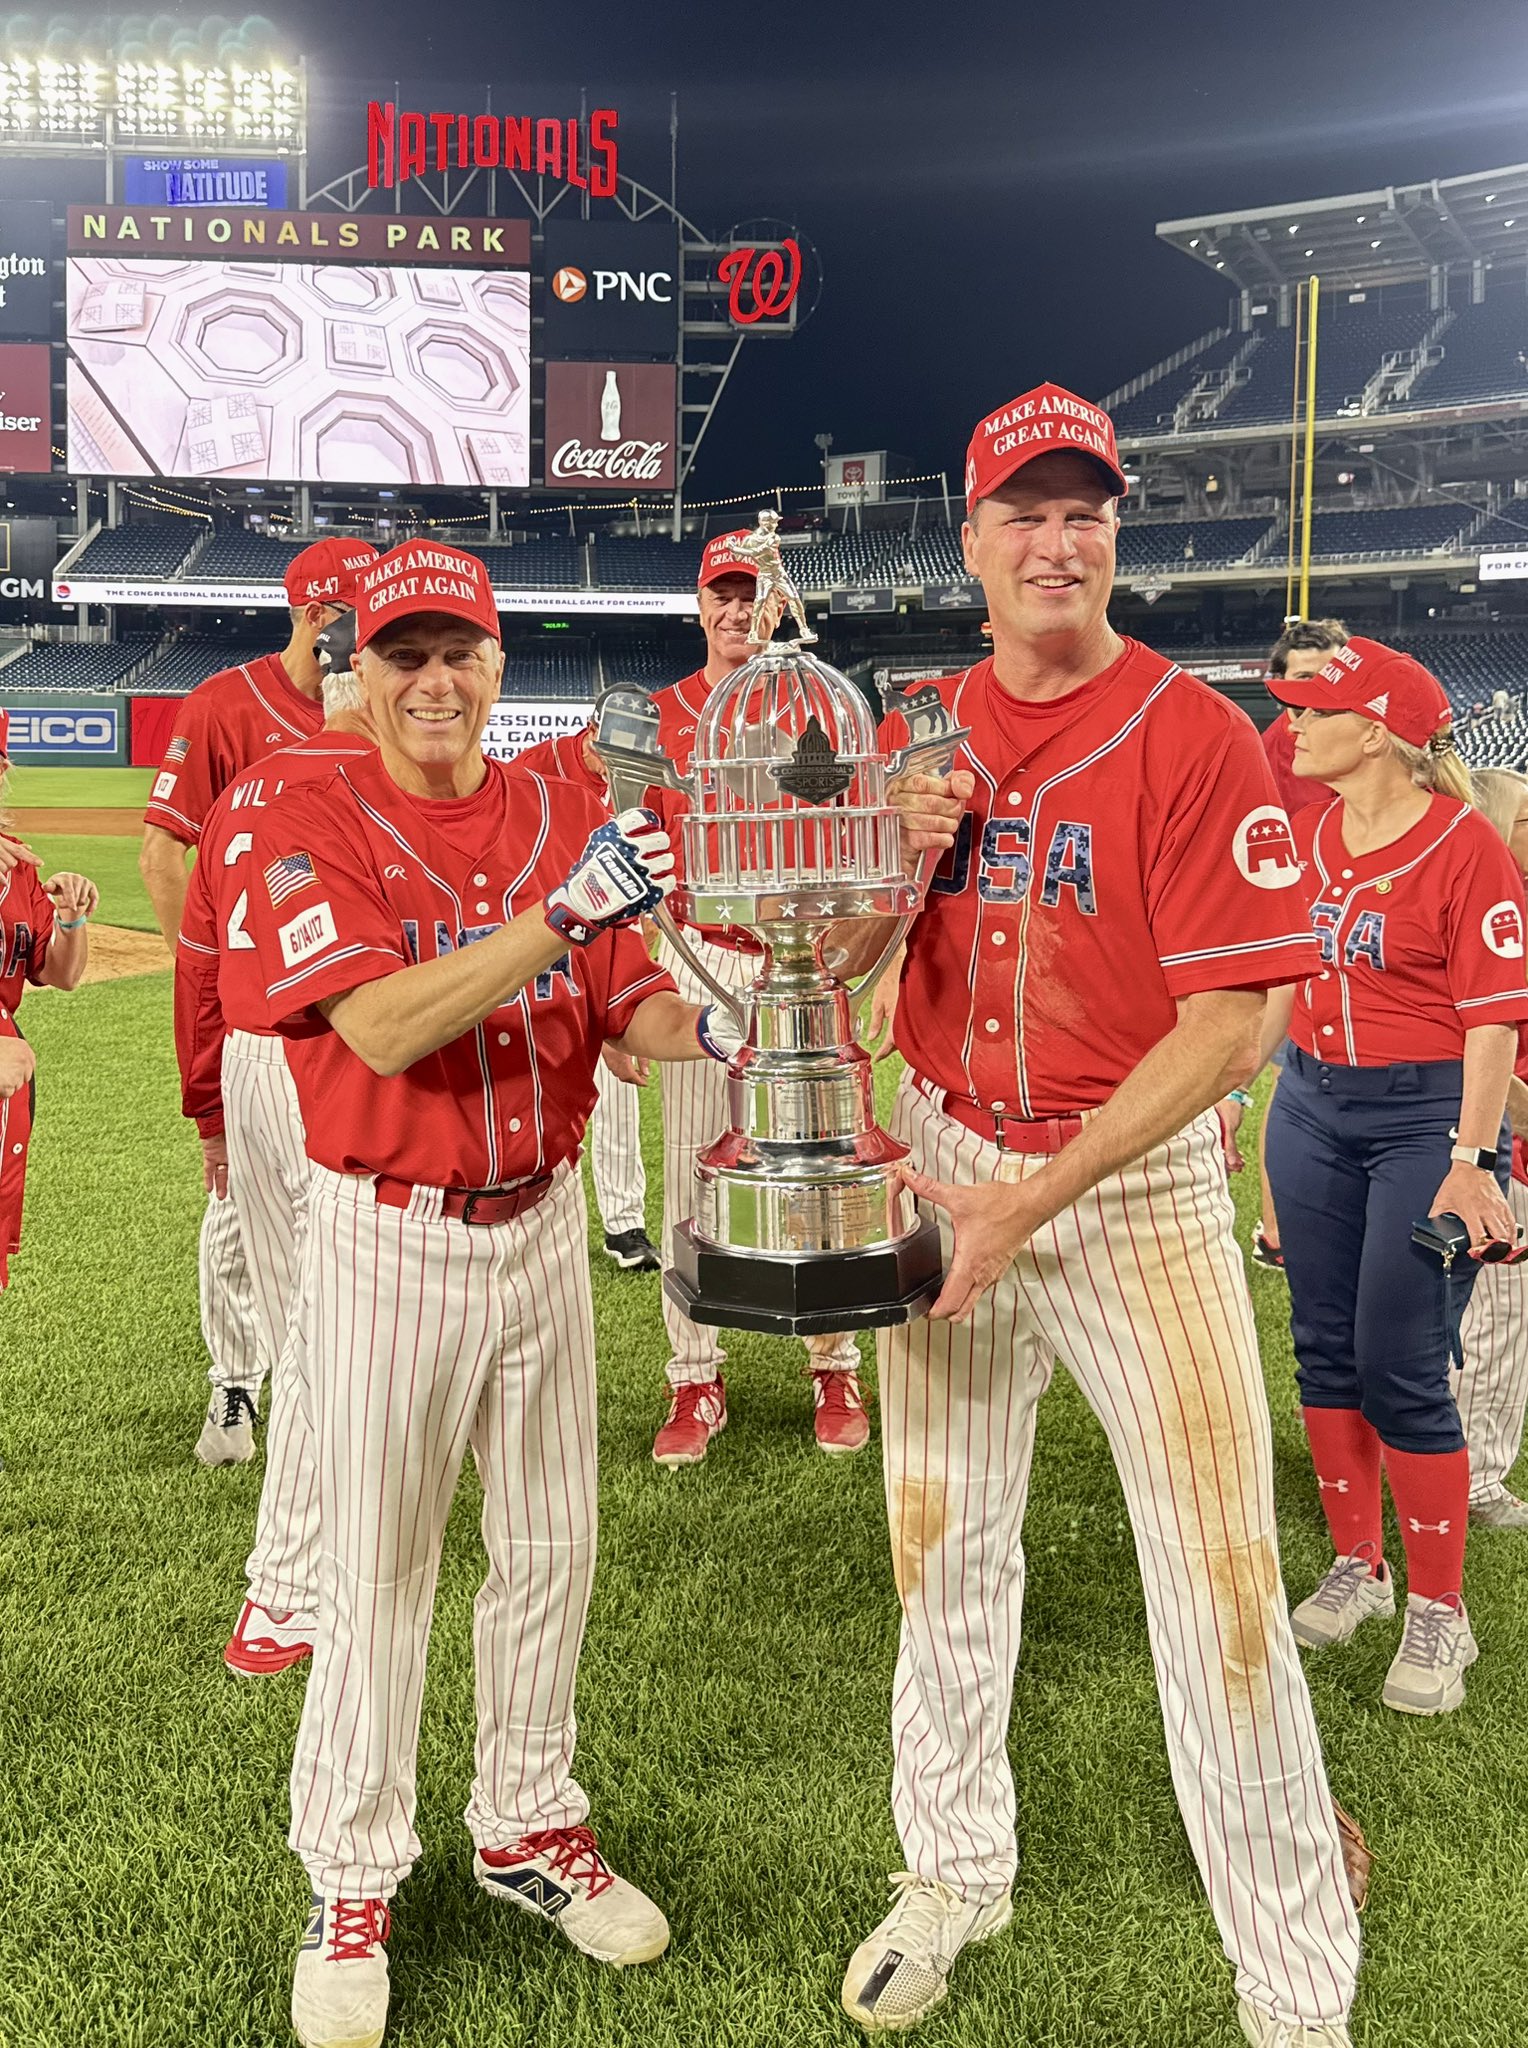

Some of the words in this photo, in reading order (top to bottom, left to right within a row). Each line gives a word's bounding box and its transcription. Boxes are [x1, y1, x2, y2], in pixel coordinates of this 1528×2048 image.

[367, 101, 618, 197] NATIONALS
[143, 160, 181, 171] SHOW
[184, 159, 218, 170] SOME
[165, 171, 267, 202] NATITUDE
[84, 215, 359, 247] NATIONALS
[387, 224, 505, 252] PARK
[593, 271, 672, 302] PNC
[984, 400, 1036, 437] MAKE
[1038, 396, 1109, 440] AMERICA
[993, 422, 1054, 456] GREAT
[1058, 422, 1107, 455] AGAIN
[551, 439, 669, 480] Coca-Cola
[342, 554, 373, 571] MAKE
[363, 556, 403, 593] MAKE
[405, 550, 479, 584] AMERICA
[1, 578, 44, 599] GM
[127, 590, 208, 598] CONGRESSIONAL
[305, 577, 338, 598] 45-47
[369, 577, 419, 612] GREAT
[422, 576, 476, 603] AGAIN
[487, 715, 590, 727] ESSIONA
[781, 766, 847, 775] CONGRESSIONAL
[796, 776, 835, 788] SPORTS
[290, 914, 324, 954] 6/14/17
